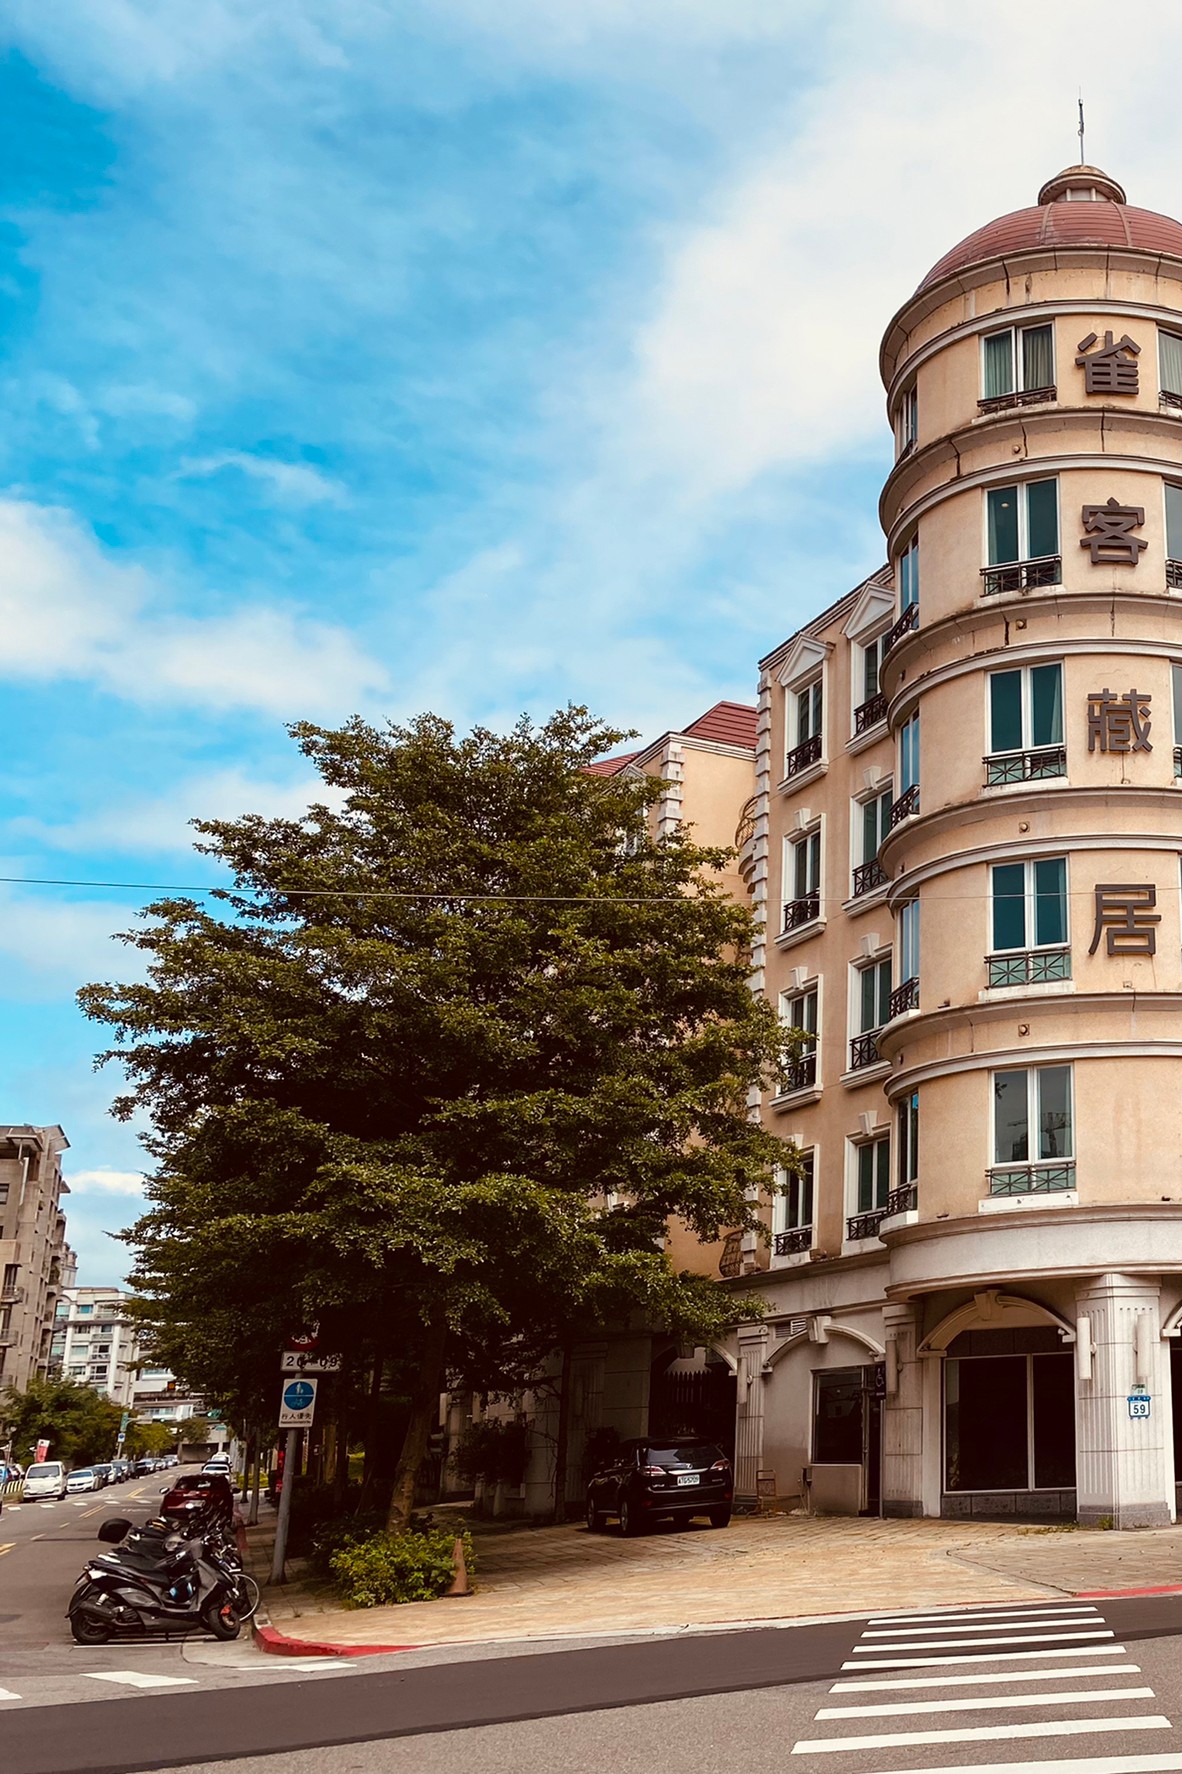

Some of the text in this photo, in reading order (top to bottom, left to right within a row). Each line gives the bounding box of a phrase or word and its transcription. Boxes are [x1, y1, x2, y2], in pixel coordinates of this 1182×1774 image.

[1075, 330, 1161, 955] 雀客藏居
[1133, 1404, 1146, 1414] 59
